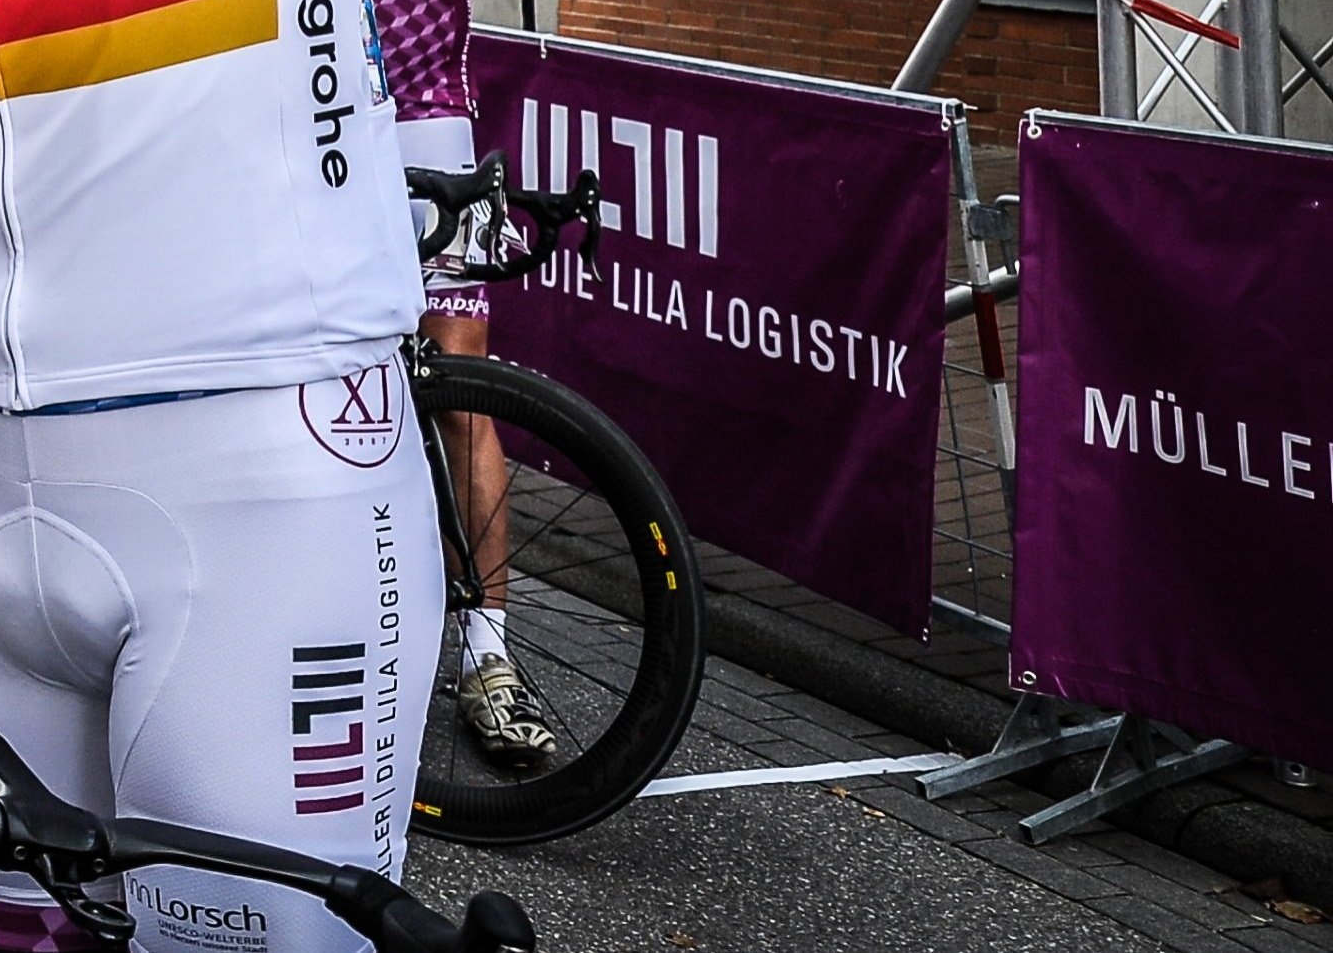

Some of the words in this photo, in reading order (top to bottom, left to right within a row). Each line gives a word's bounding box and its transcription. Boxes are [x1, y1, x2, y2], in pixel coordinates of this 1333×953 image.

[612, 261, 688, 332] LILA
[705, 288, 908, 398] LOGISTIK
[330, 363, 393, 425] XI
[1083, 385, 1333, 504] MÜLLE
[372, 502, 401, 648] LOGISTIK
[377, 656, 400, 724] LILA
[375, 732, 398, 784] DIE
[155, 887, 268, 933] Lorsch
